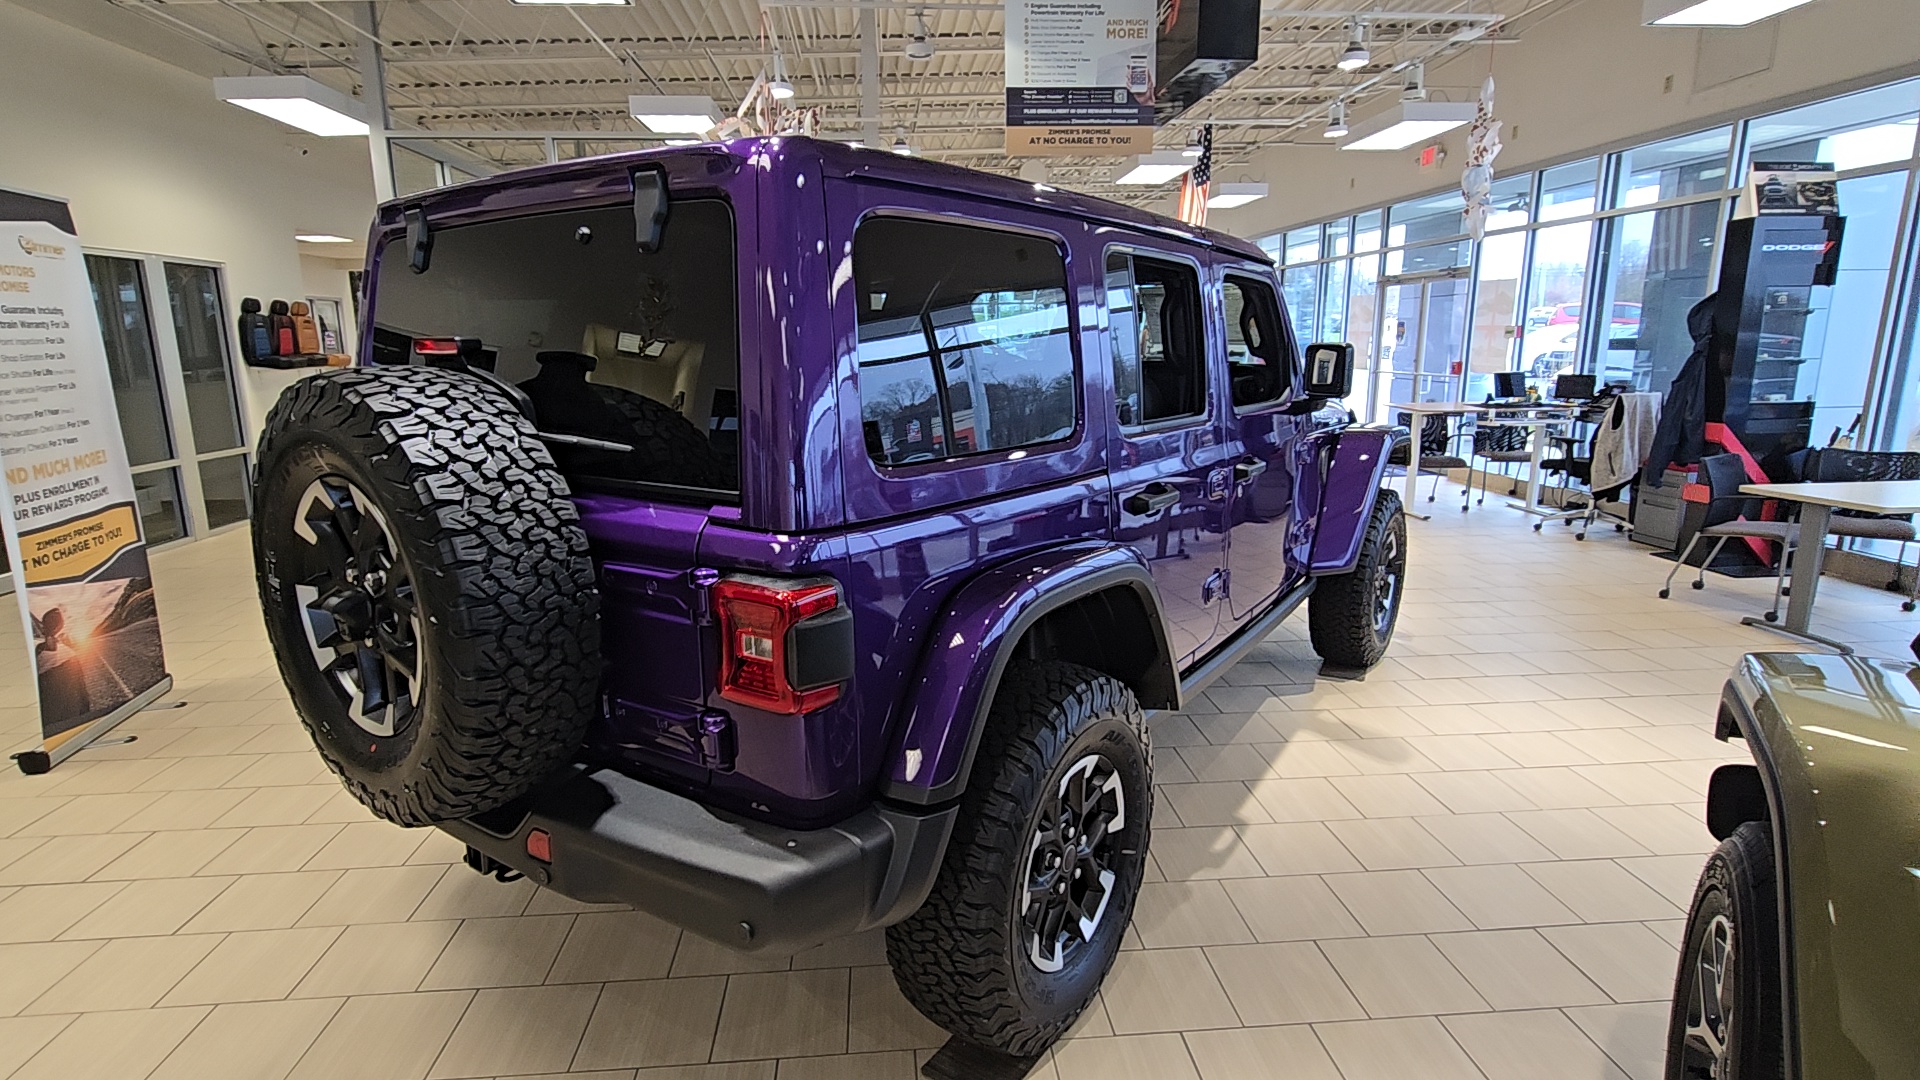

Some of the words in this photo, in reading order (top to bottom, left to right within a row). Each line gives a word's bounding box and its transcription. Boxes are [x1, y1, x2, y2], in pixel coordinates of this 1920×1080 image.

[1106, 28, 1148, 39] MORE!
[0, 281, 30, 292] OMISE
[1, 305, 36, 314] Guarantee
[37, 306, 64, 316] Including
[19, 320, 49, 330] Warranty
[32, 458, 71, 480] MUCH
[73, 449, 108, 470] MORE!
[14, 490, 41, 506] PLUS
[42, 478, 92, 499] ENROLLMENT
[31, 497, 74, 517] REWARDS
[74, 486, 110, 505] PROGRAM!
[32, 554, 50, 568] NO
[52, 539, 91, 561] CHARGE
[92, 534, 105, 547] TO
[105, 526, 123, 542] YOU!
[35, 533, 74, 551] ZIMMER'S
[73, 522, 104, 539] PROMISE
